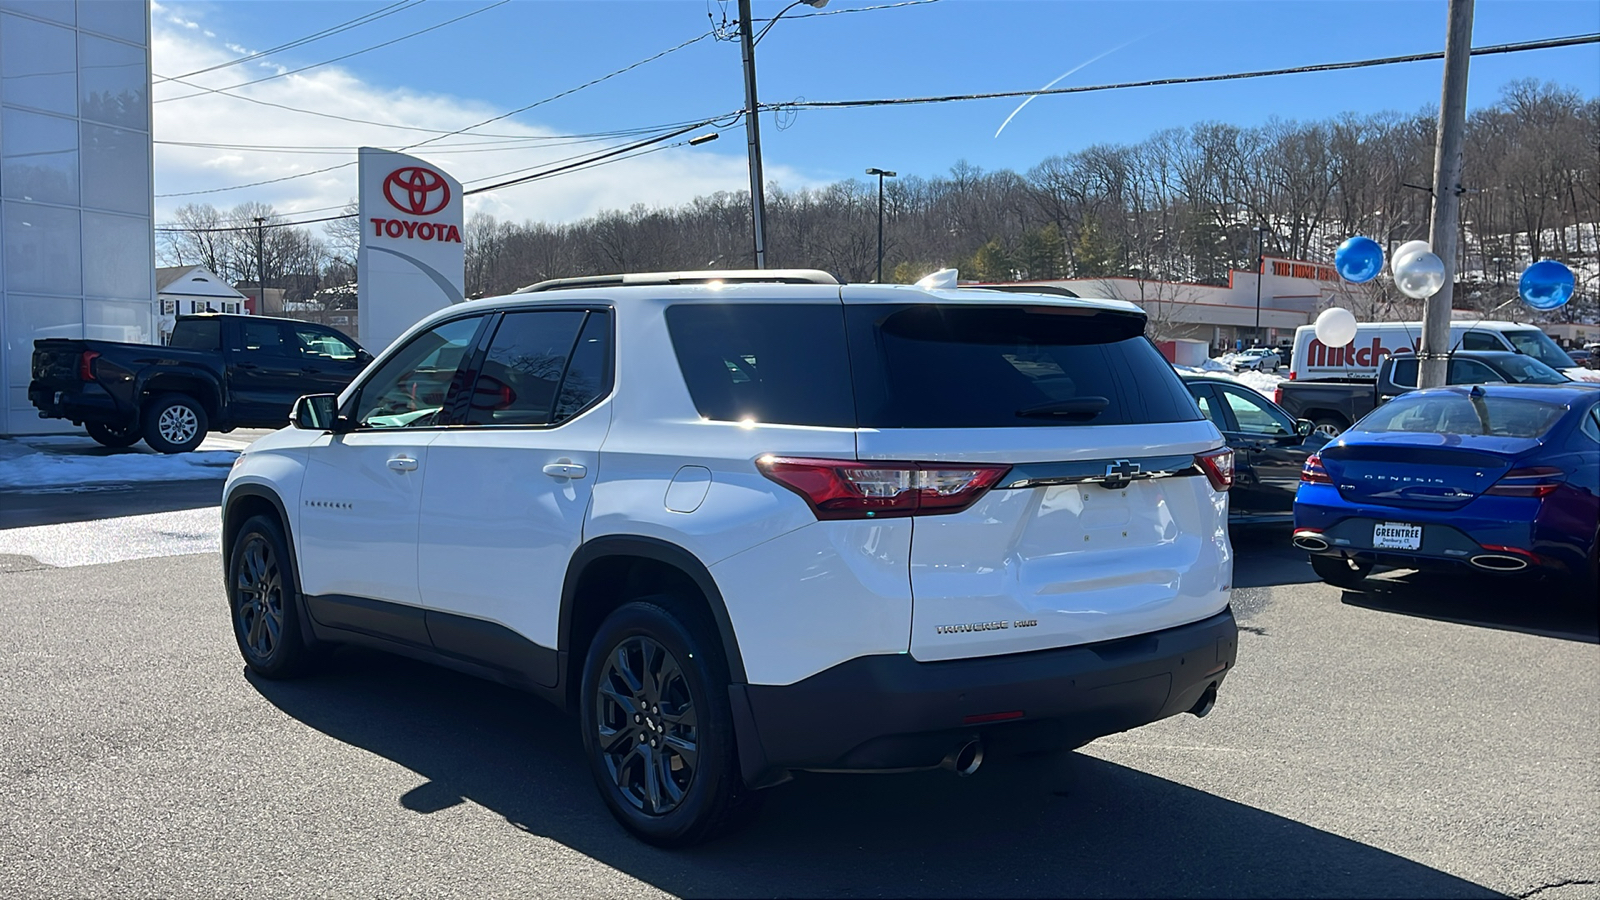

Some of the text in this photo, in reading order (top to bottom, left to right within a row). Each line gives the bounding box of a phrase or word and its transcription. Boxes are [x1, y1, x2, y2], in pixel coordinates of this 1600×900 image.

[370, 218, 462, 243] TOYOTA
[1273, 261, 1290, 277] THE
[1292, 263, 1315, 280] HOME
[1364, 474, 1444, 483] GENESIS
[1375, 528, 1420, 538] GREENTREE
[936, 619, 1038, 634] TRAVERSE AWD
